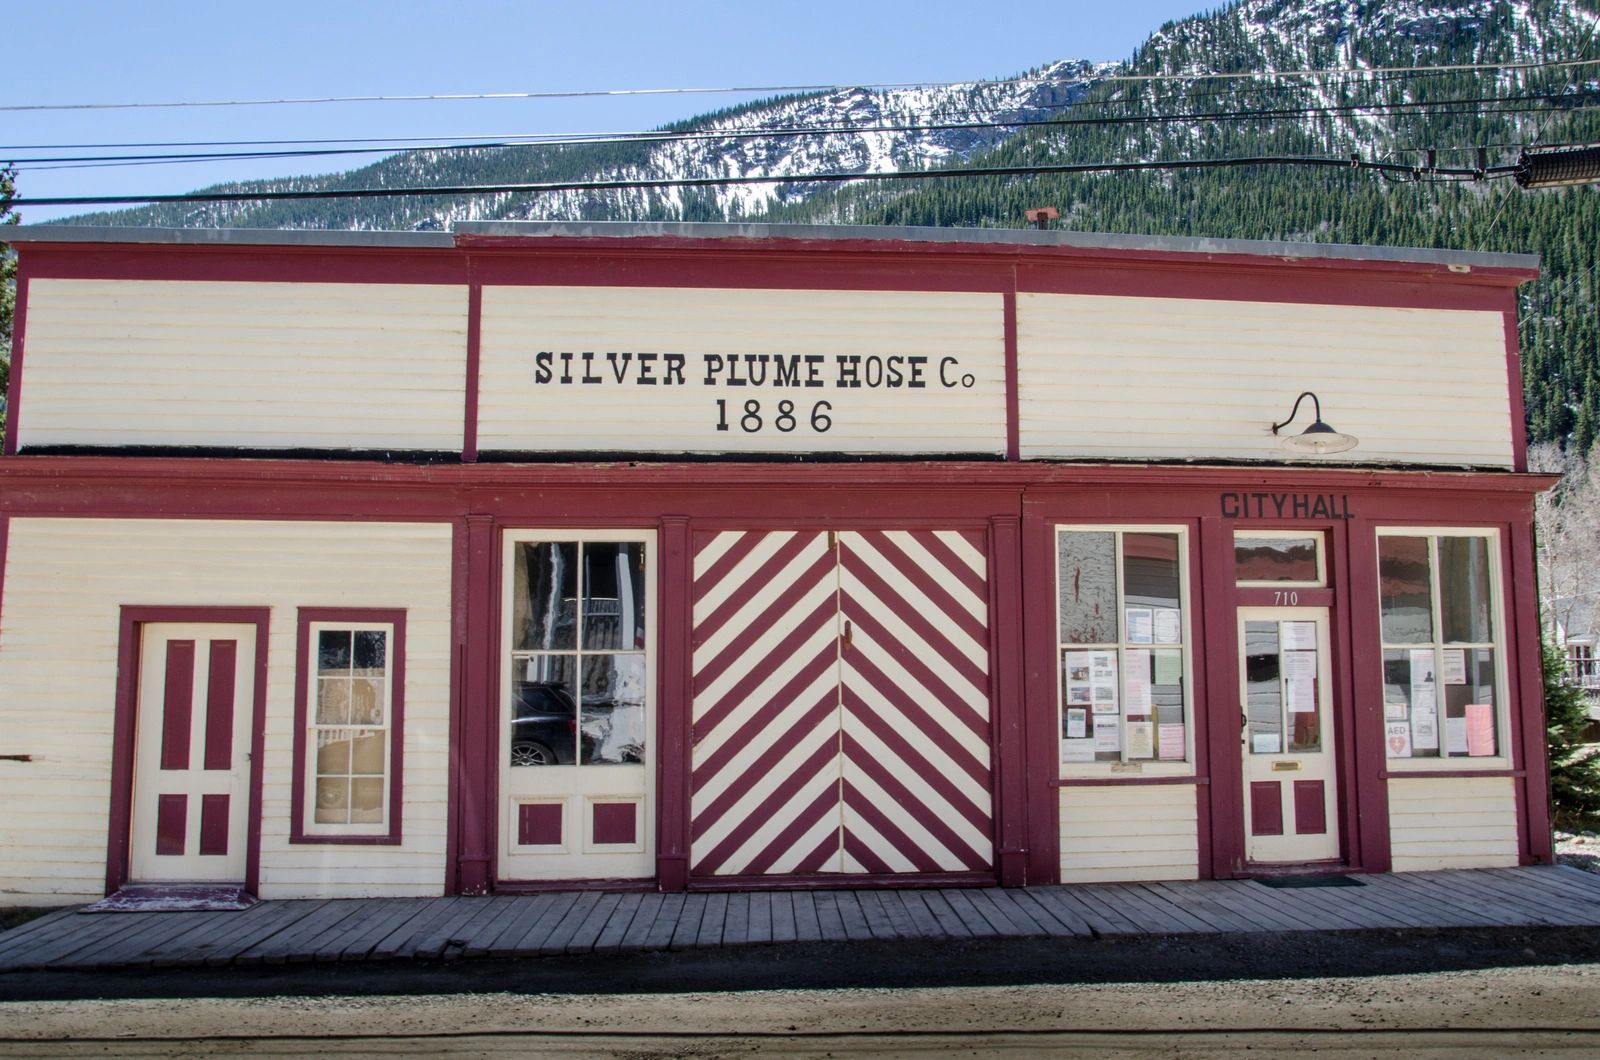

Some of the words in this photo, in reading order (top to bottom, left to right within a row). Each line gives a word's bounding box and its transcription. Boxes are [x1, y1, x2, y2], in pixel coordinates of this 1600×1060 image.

[535, 351, 686, 385] SILVER
[703, 354, 825, 388] PLUME
[835, 355, 928, 389] HOSE
[939, 356, 976, 389] Co
[716, 398, 833, 433] 1886
[1220, 492, 1287, 518] CITY
[1292, 493, 1355, 519] HALL
[1274, 591, 1298, 606] 710
[1388, 726, 1406, 735] AED
